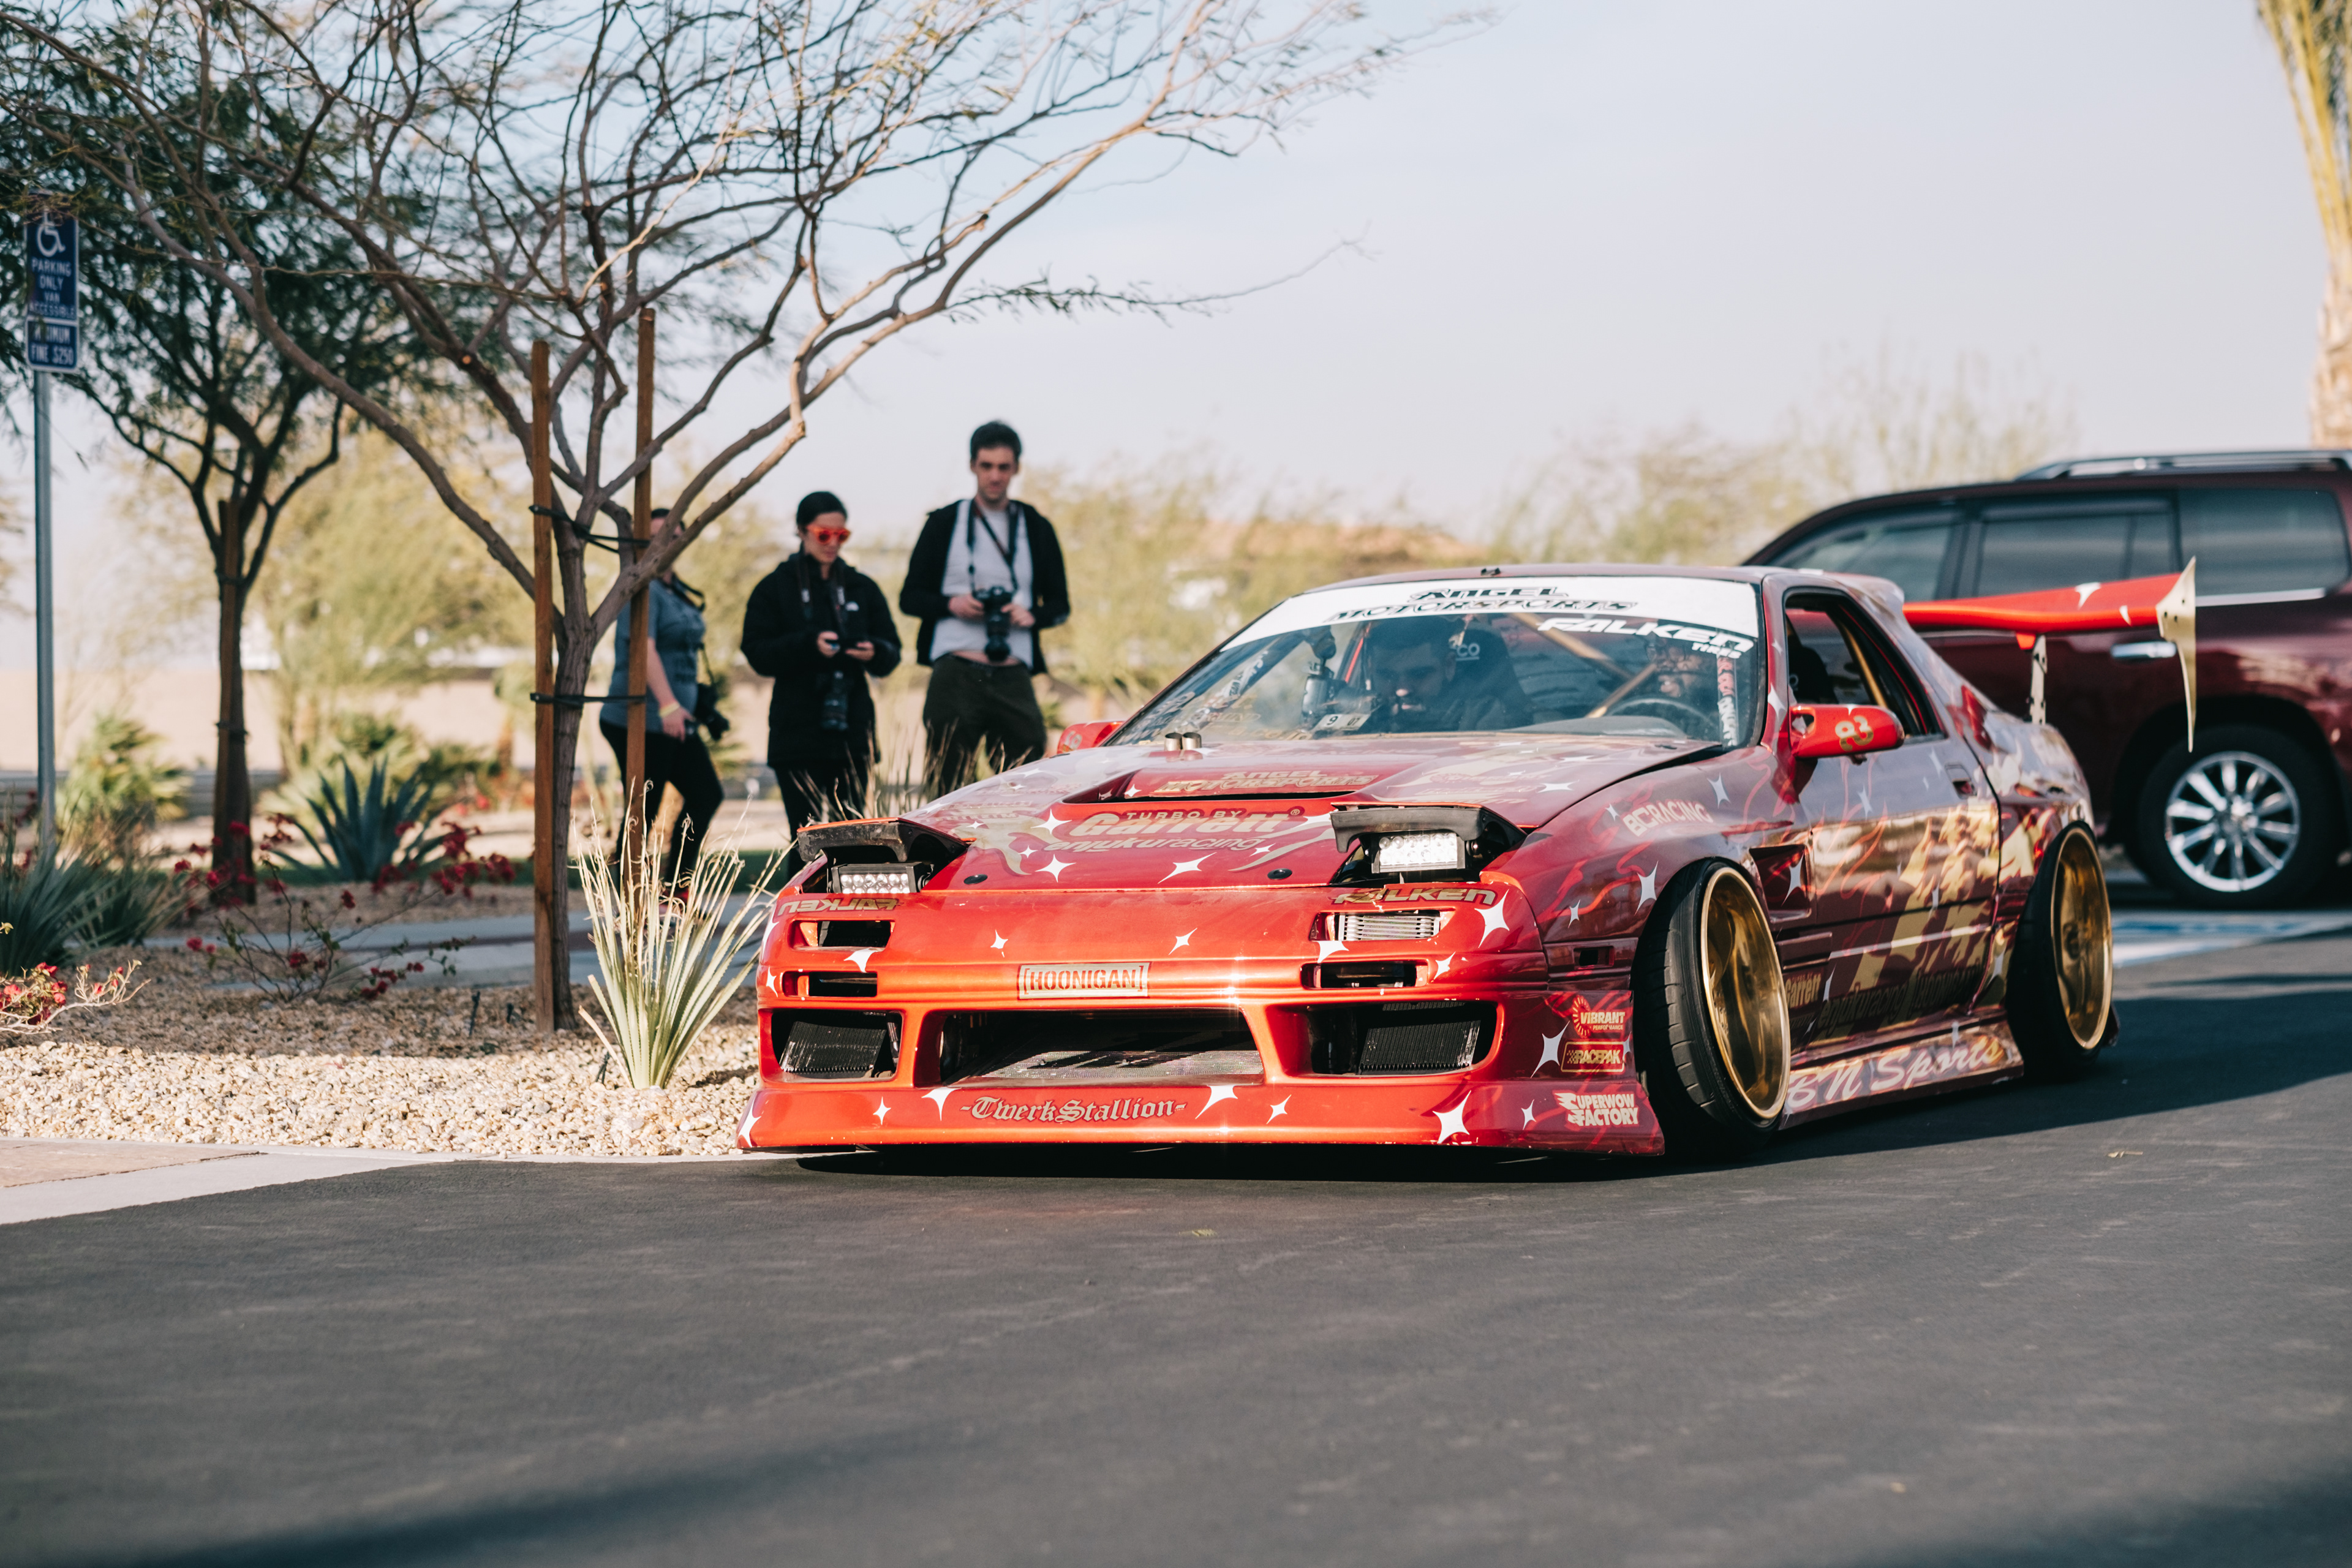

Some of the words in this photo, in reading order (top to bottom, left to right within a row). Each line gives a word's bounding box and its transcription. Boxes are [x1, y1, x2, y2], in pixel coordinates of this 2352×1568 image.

[31, 257, 72, 277] PARKING
[39, 274, 64, 290] ONLY
[44, 291, 60, 304] VAN
[31, 343, 49, 363] FINE
[51, 345, 74, 366] $250
[1409, 586, 1569, 603] ANGEL
[1324, 599, 1639, 623] MOTORSPORTS
[1536, 617, 1754, 654] FALKEN
[1153, 774, 1379, 793] MOTORSPORTS
[1224, 770, 1328, 780] ANGEL
[1126, 811, 1200, 820] TURBO
[1215, 810, 1242, 819] BY
[1069, 813, 1290, 837] Garrett
[1332, 888, 1496, 905] FALKEN
[1580, 1011, 1626, 1024] VIBRANT
[1574, 1049, 1621, 1065] RACEPAK
[1871, 1035, 2005, 1090] Sports
[1555, 1092, 1635, 1110] SUPERWOW
[1568, 1107, 1638, 1126] FACTORY
